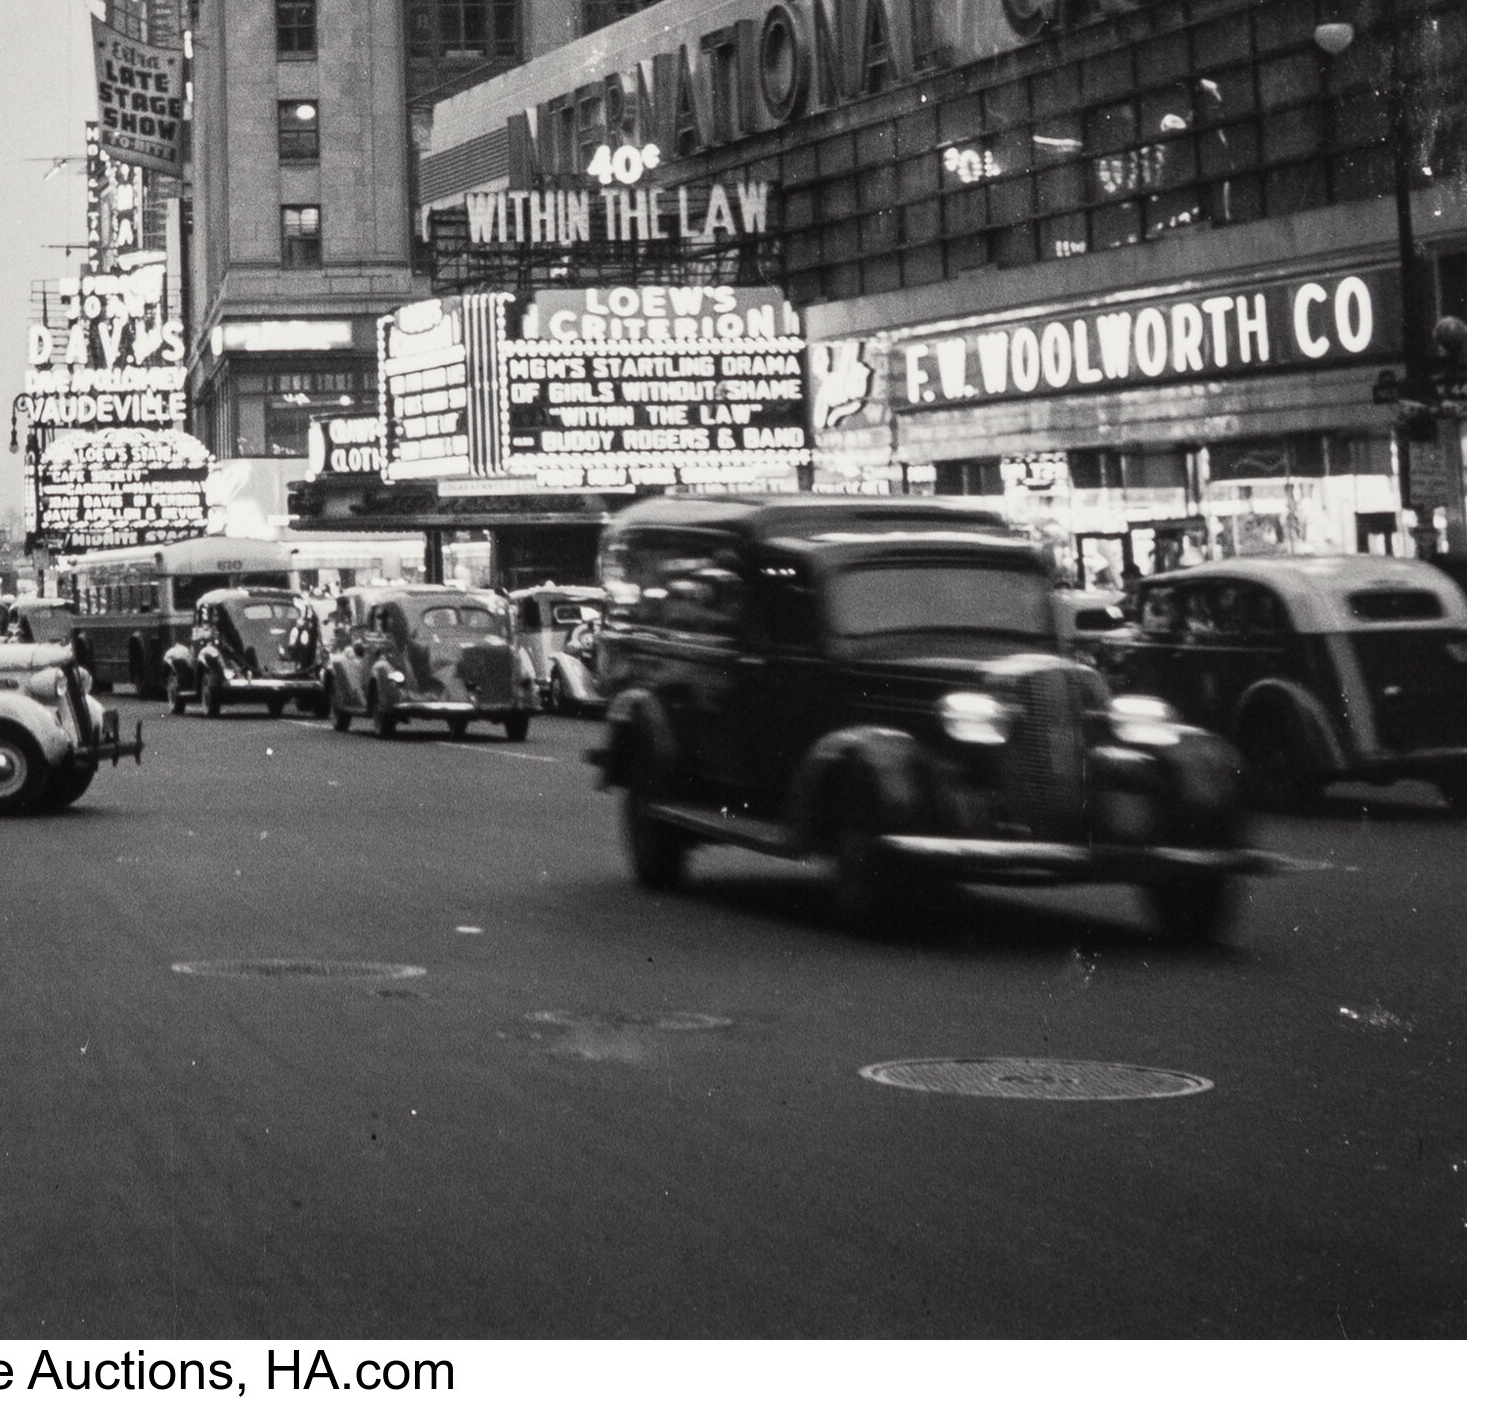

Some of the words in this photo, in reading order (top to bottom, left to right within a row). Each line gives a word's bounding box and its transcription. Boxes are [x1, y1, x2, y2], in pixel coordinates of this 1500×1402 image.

[105, 59, 169, 93] LATE
[99, 81, 182, 119] STAGE
[102, 107, 177, 141] SHOW
[587, 143, 660, 185] 40¢
[465, 188, 591, 243] WITHIN
[600, 187, 667, 241] THE
[678, 180, 770, 239] LAW
[586, 285, 737, 317] LOEW'S
[549, 304, 775, 341] CRITERION
[977, 293, 1270, 395] WOOLWORTH
[1293, 276, 1374, 359] CO
[509, 357, 587, 380] MGM'S
[592, 355, 716, 379] STARTLING
[721, 354, 803, 377] DRAMA
[26, 393, 188, 423] VAUDEVILLE
[509, 382, 541, 404] OF
[548, 381, 616, 404] GIRLS
[621, 380, 718, 402] WITHOUT
[725, 379, 804, 401] SHAME
[645, 404, 690, 426] THE
[77, 446, 128, 462] LOEW'S
[131, 446, 172, 462] STATE
[542, 430, 615, 453] BUDDY
[622, 428, 711, 451] ROGERS
[716, 427, 737, 449] &
[742, 427, 805, 449] BAND
